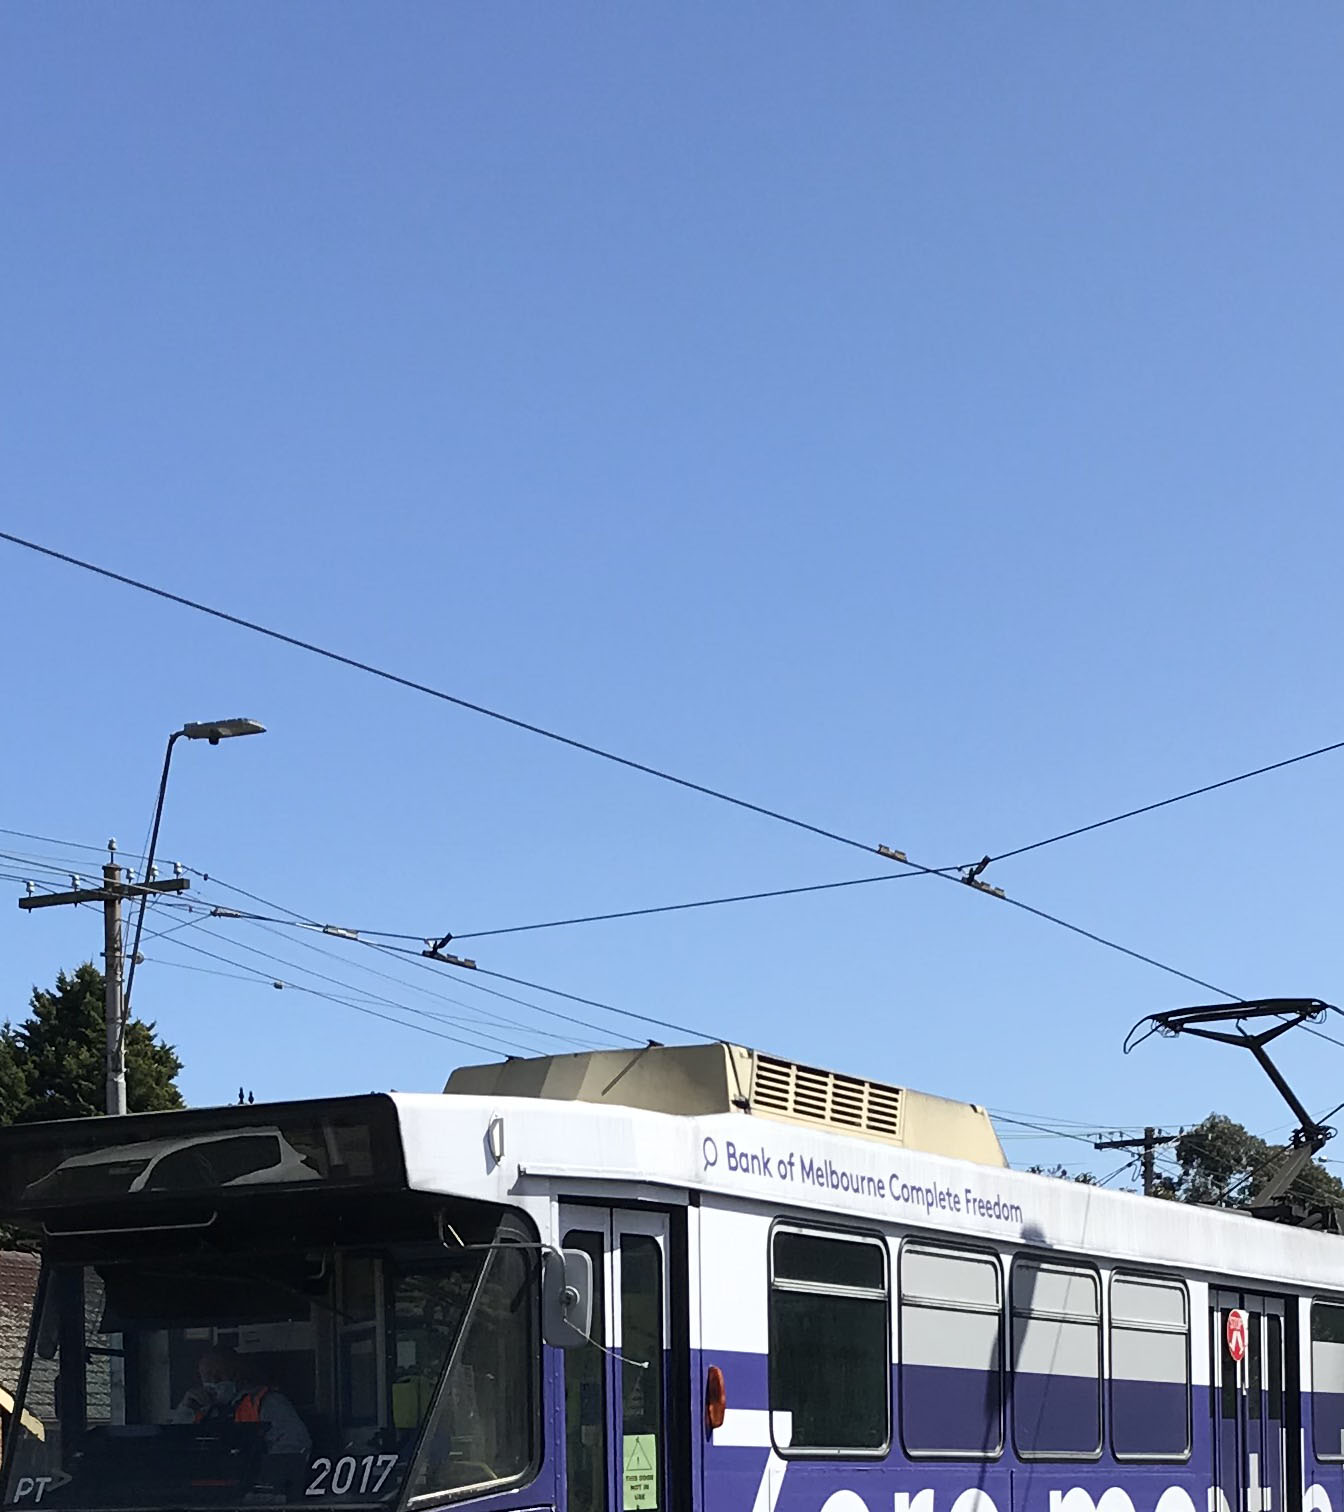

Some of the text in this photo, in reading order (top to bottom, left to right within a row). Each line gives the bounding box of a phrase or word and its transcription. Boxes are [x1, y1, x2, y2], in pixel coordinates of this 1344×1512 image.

[725, 1141, 1024, 1224] Bank of Melbourne Complete Freedom
[305, 1454, 398, 1496] 2017
